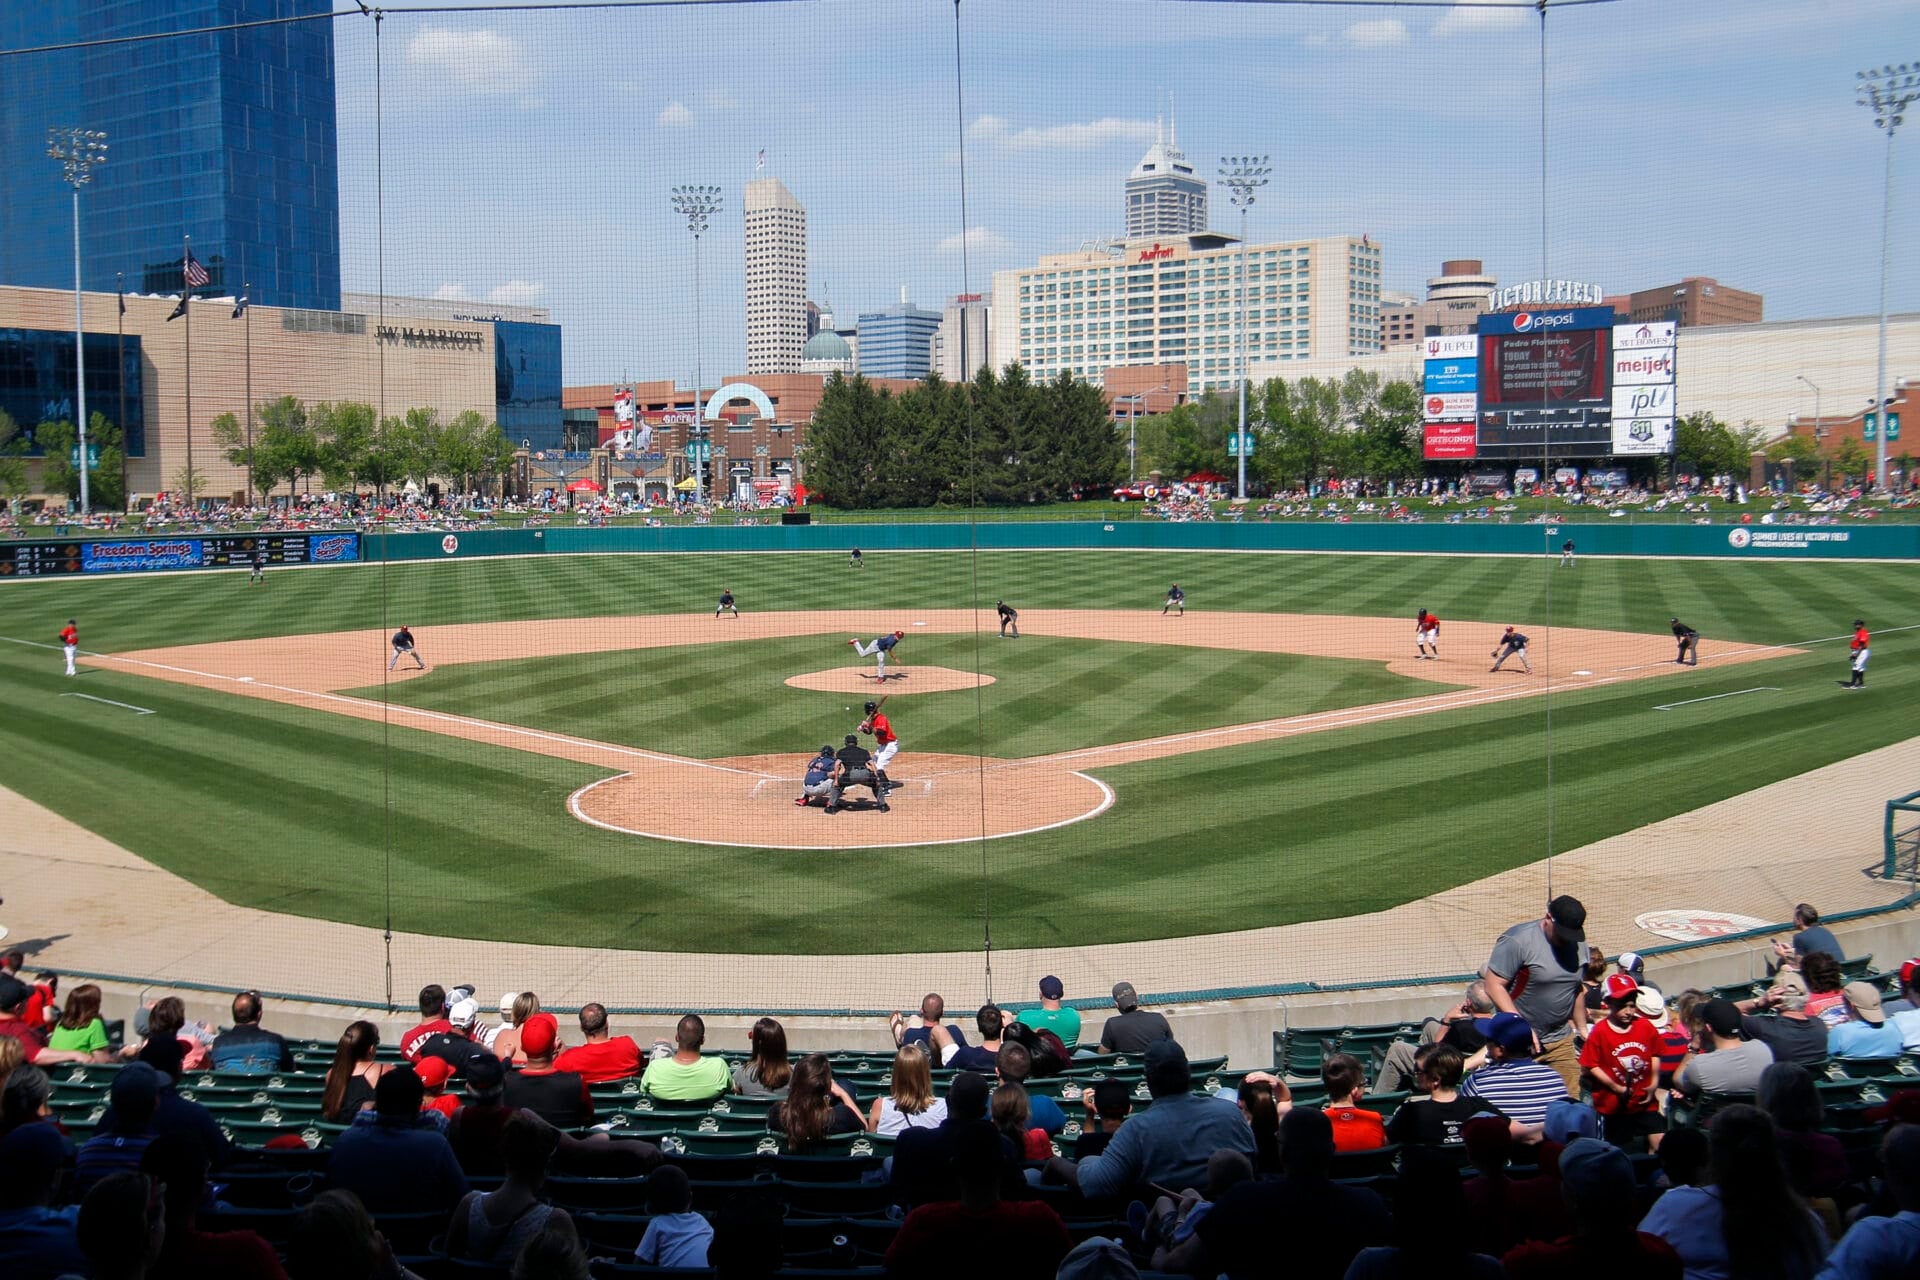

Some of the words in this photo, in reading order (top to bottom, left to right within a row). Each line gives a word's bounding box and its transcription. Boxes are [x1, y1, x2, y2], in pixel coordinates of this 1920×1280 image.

[1487, 280, 1552, 311] VICTORY
[1555, 280, 1602, 304] FIELD
[1534, 313, 1574, 328] pepsi
[374, 326, 398, 338] JW
[402, 327, 483, 343] MARRIOTT
[1504, 340, 1529, 348] Pedro
[1504, 351, 1530, 360] TODAY
[1616, 356, 1670, 375] meijer
[1631, 388, 1656, 416] ipl
[1630, 420, 1652, 436] 811
[443, 537, 457, 550] 42
[1752, 533, 1777, 541] SUMMER
[1778, 533, 1794, 541] LIVES
[1804, 533, 1829, 541] VICTORY
[1831, 533, 1848, 541] FIELD
[92, 543, 146, 558] Freedom
[148, 541, 192, 557] Springs
[84, 559, 137, 570] Greenwood
